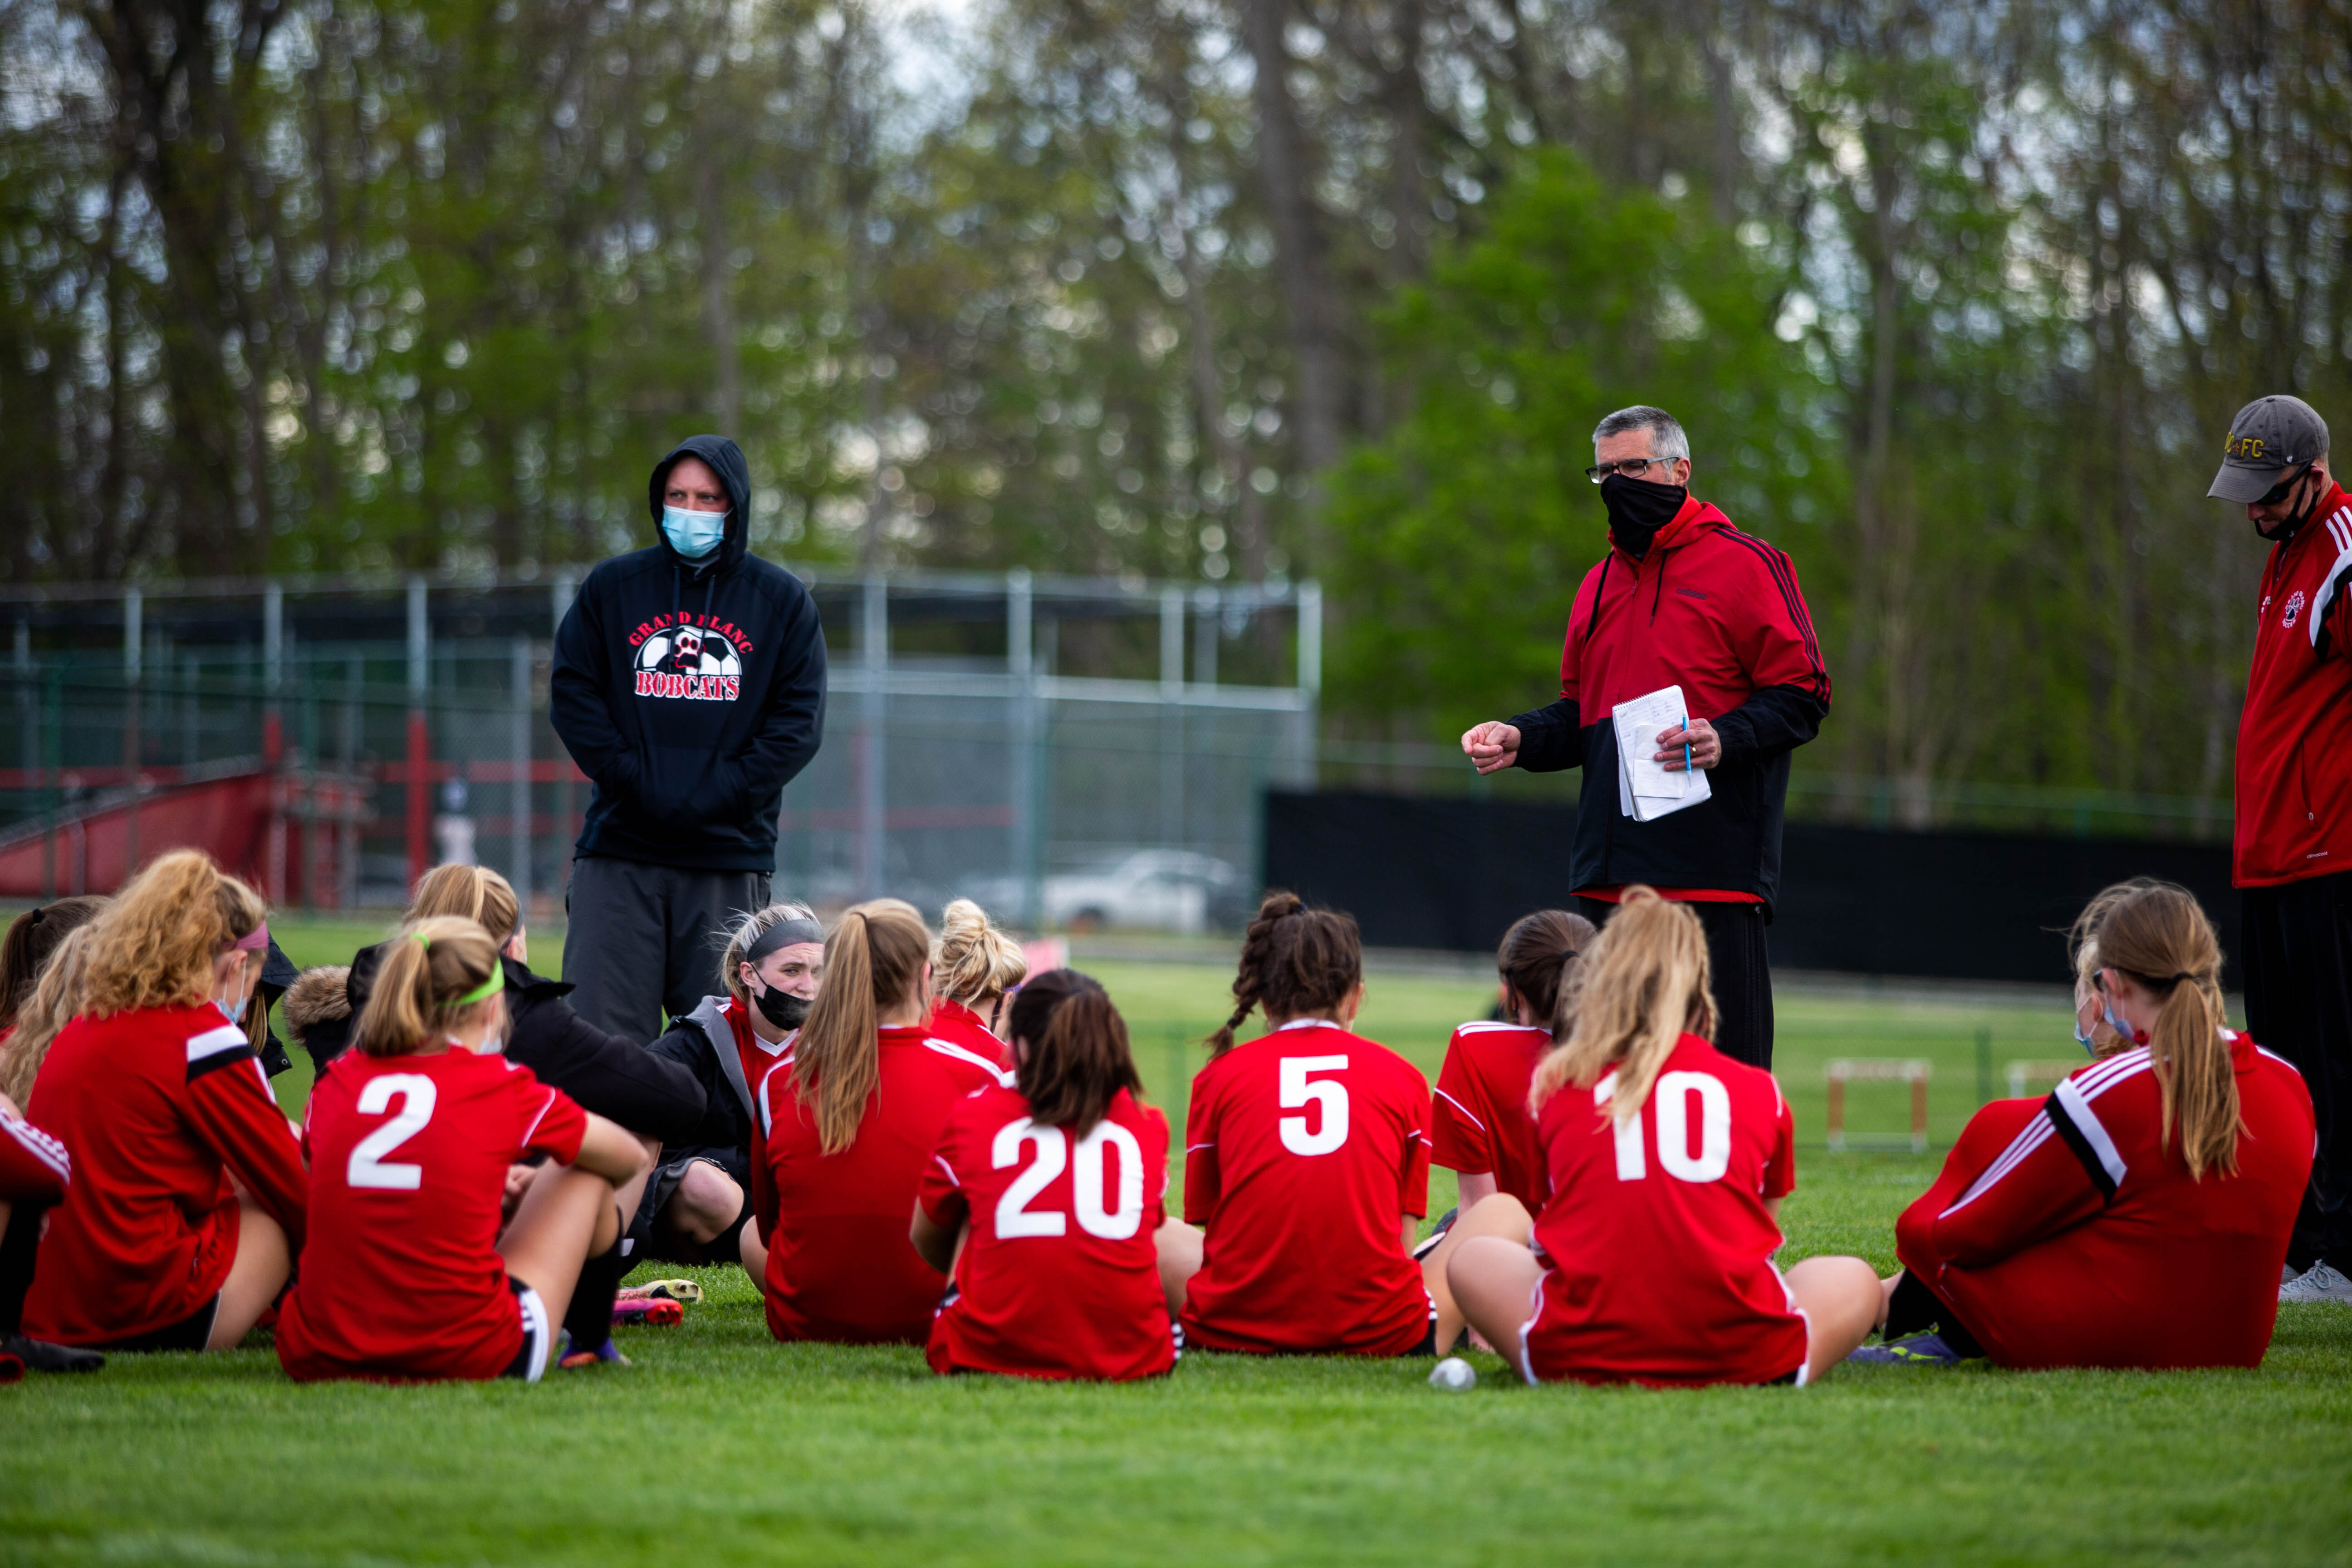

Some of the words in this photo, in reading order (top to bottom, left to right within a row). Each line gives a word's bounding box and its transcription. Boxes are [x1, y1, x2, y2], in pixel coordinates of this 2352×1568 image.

[2240, 438, 2264, 458] FC
[1676, 588, 1706, 600] adidas
[635, 671, 740, 701] BOBCATS
[347, 1073, 437, 1190] 2
[1279, 1054, 1349, 1156] 5
[1594, 1070, 1731, 1183] 10
[992, 1116, 1144, 1240] 20
